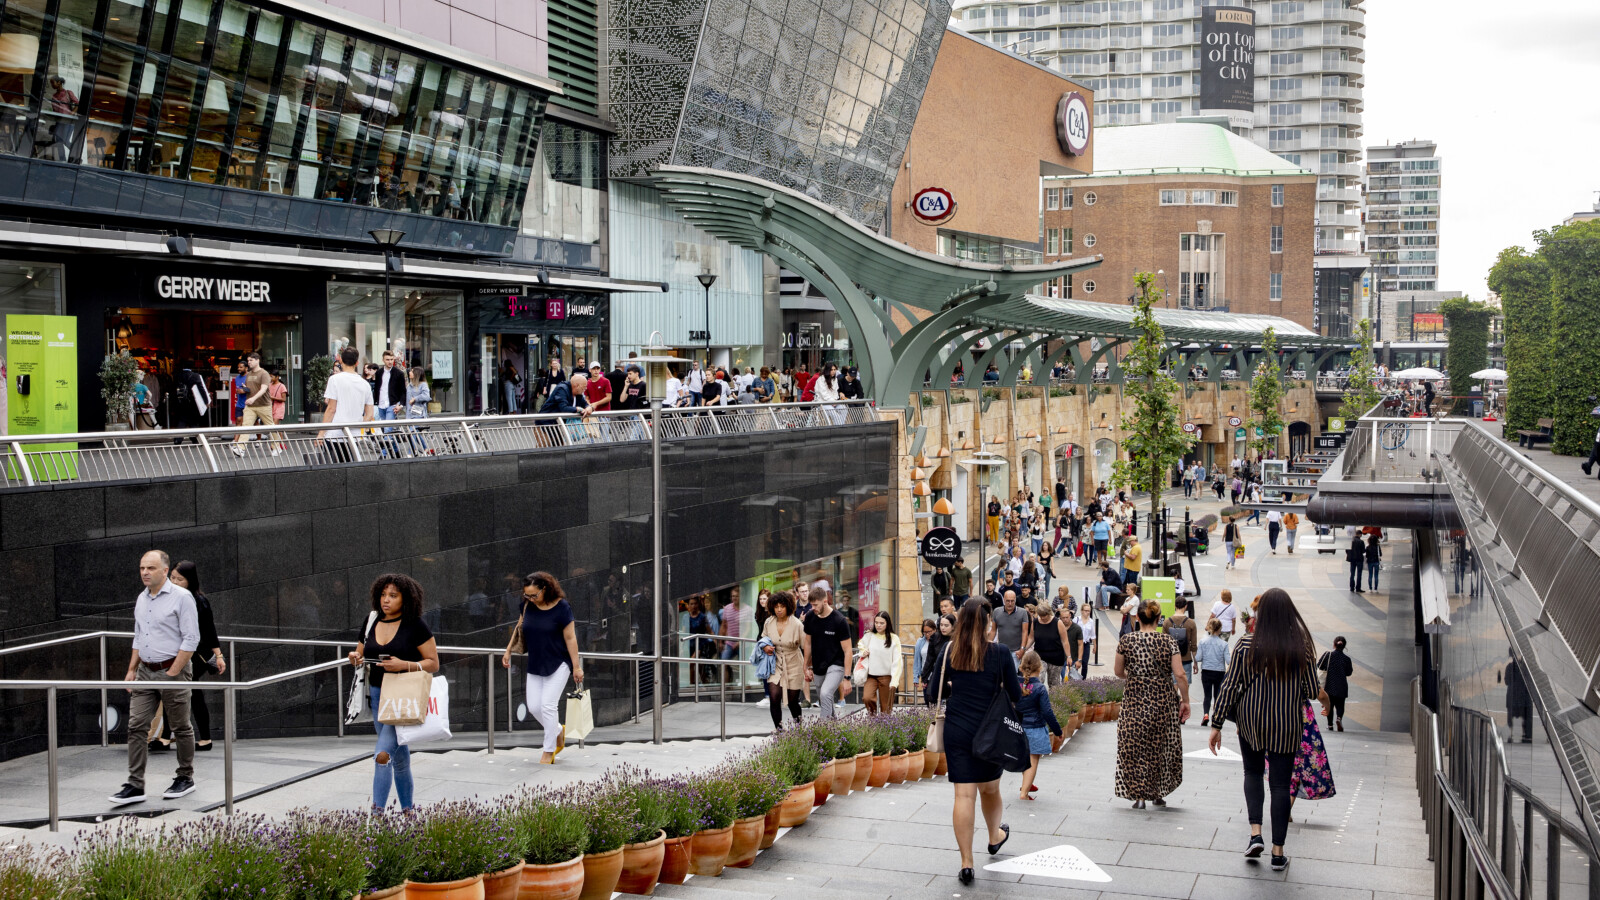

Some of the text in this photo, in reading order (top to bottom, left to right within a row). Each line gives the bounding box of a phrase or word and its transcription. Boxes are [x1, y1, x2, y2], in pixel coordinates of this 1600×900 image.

[1219, 11, 1251, 22] FORUM
[1206, 30, 1254, 50] on top
[1208, 43, 1253, 64] of the
[1219, 61, 1248, 83] city
[1069, 108, 1086, 139] C&A
[920, 197, 945, 211] C&A
[158, 275, 271, 302] GERRY WEBER
[571, 304, 595, 316] HUAWEI
[689, 330, 712, 341] ZARA
[1319, 439, 1335, 447] WE
[378, 697, 421, 721] ZARA
